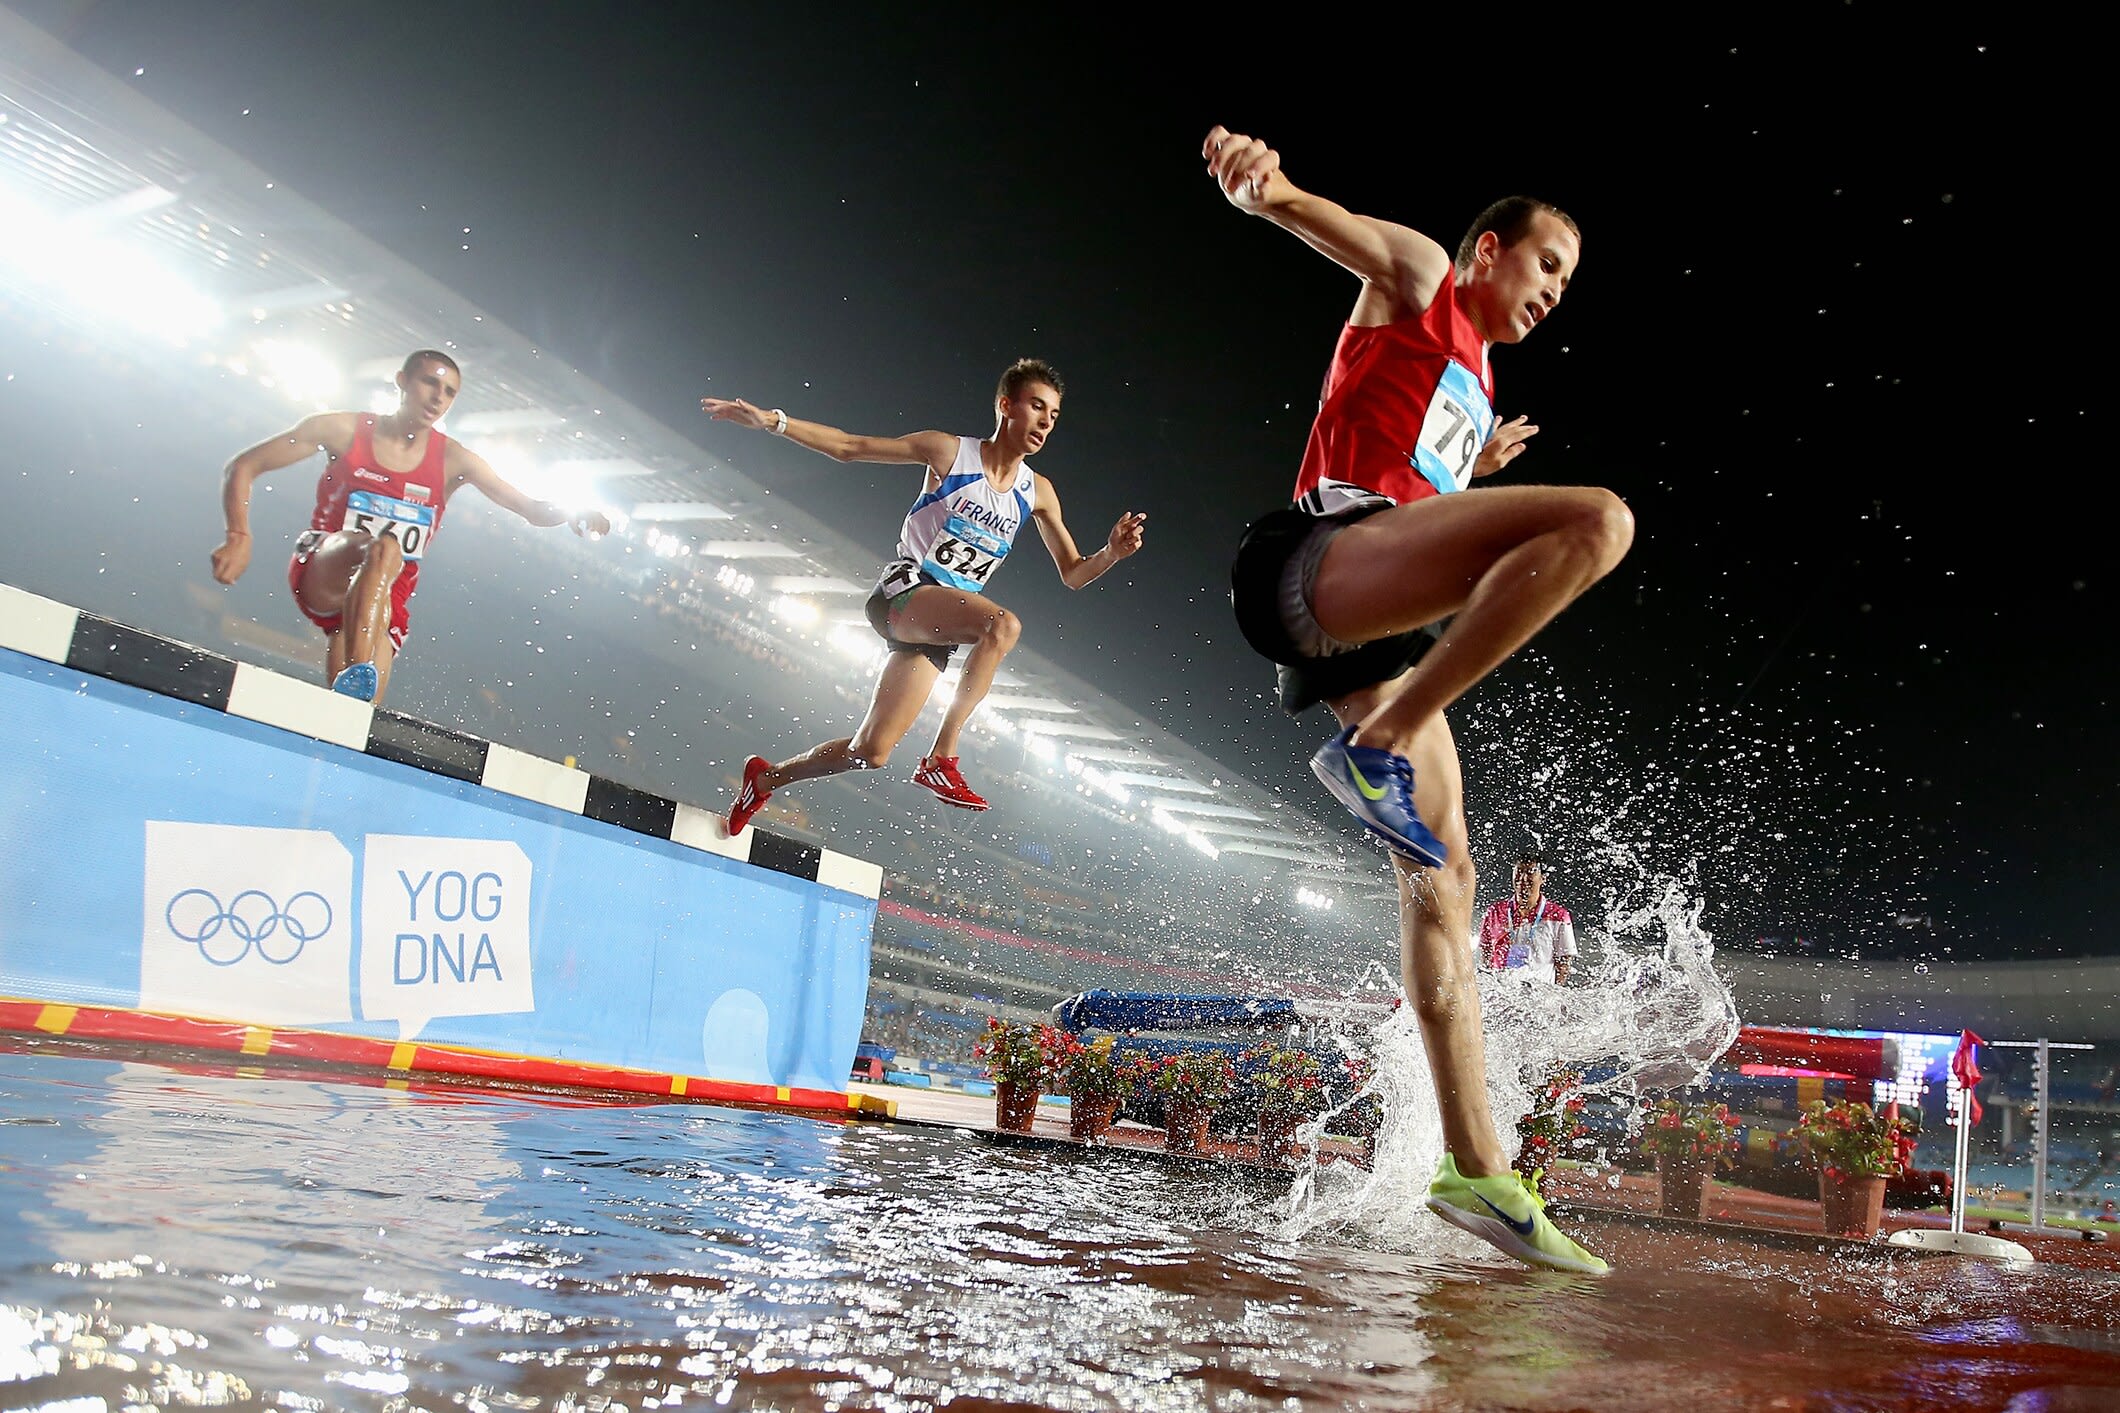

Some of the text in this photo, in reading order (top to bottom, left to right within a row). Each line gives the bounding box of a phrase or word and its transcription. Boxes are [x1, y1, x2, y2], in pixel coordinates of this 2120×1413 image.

[960, 500, 1017, 535] FRANCE
[935, 538, 995, 581] 624
[397, 870, 503, 922] YOG
[394, 933, 503, 985] DNA
